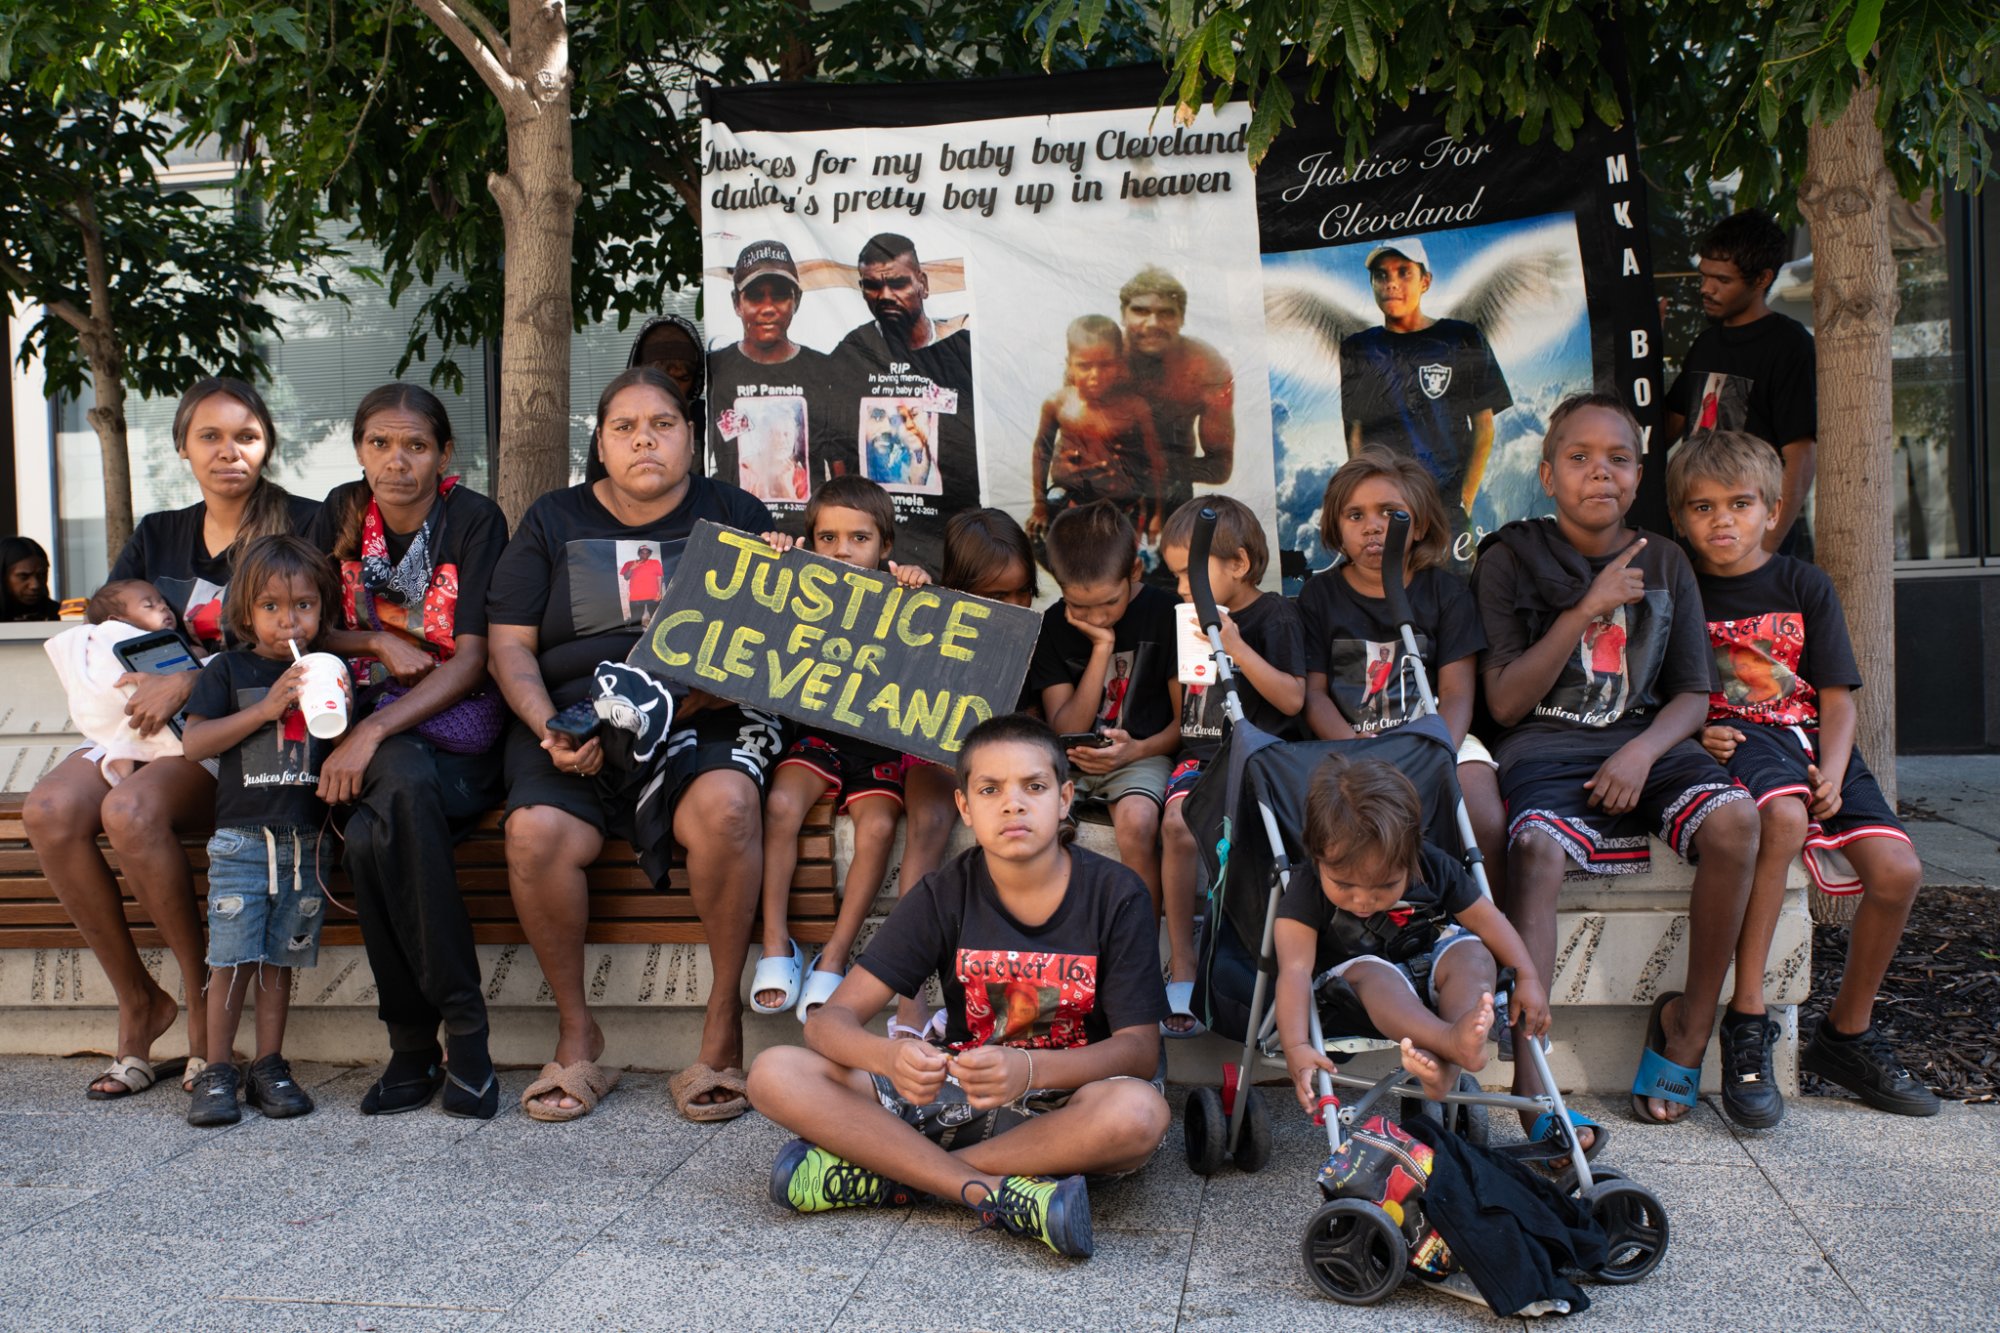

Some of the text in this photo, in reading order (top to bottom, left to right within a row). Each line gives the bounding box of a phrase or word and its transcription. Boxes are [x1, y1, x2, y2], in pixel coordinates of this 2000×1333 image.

[701, 123, 1246, 185] Justices for my baby boy Cleveland
[1281, 132, 1493, 203] Justice For
[833, 187, 926, 224] pretty
[942, 183, 995, 217] boy
[1015, 181, 1054, 214] up
[1071, 174, 1103, 202] in
[1121, 168, 1231, 200] heaven
[1318, 186, 1485, 240] Cleveland
[890, 362, 911, 374] RIP
[868, 374, 876, 382] In
[878, 374, 899, 384] loving
[736, 383, 804, 397] RIP Pamela
[871, 385, 880, 395] of
[882, 387, 894, 396] my
[896, 385, 912, 396] baby
[705, 531, 991, 662] JUSTICE
[1772, 615, 1795, 636] 16
[787, 624, 887, 676] FOR
[652, 609, 993, 753] CLEVELAND
[1193, 723, 1222, 737] Clevela
[1362, 720, 1378, 732] for
[243, 772, 280, 788] Justices
[280, 769, 296, 785] for
[961, 952, 1085, 982] forever 16
[1656, 1077, 1690, 1097] PUMA
